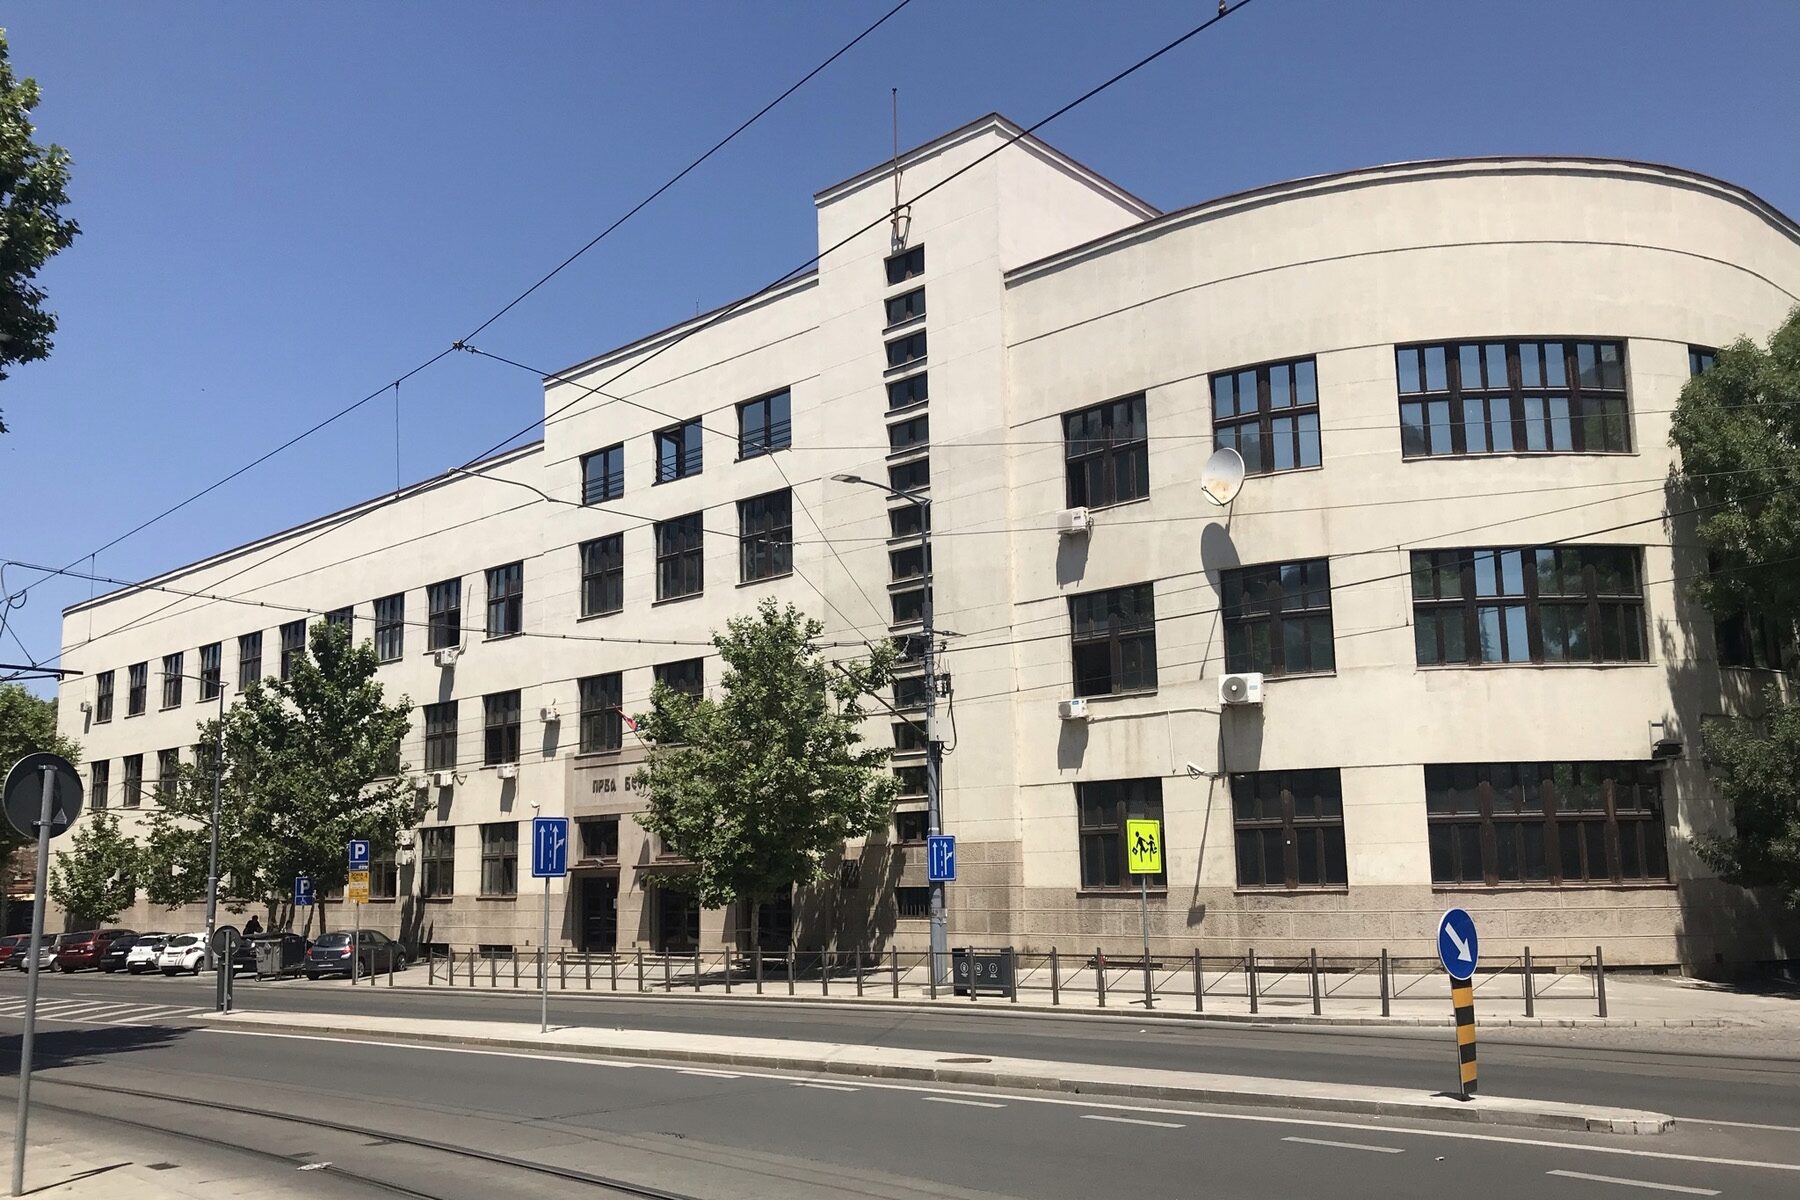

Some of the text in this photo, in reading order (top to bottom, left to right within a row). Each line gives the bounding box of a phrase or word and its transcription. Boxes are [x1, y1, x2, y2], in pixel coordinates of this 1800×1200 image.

[592, 778, 617, 794] ПРВА
[354, 843, 366, 859] P
[300, 879, 310, 894] P
